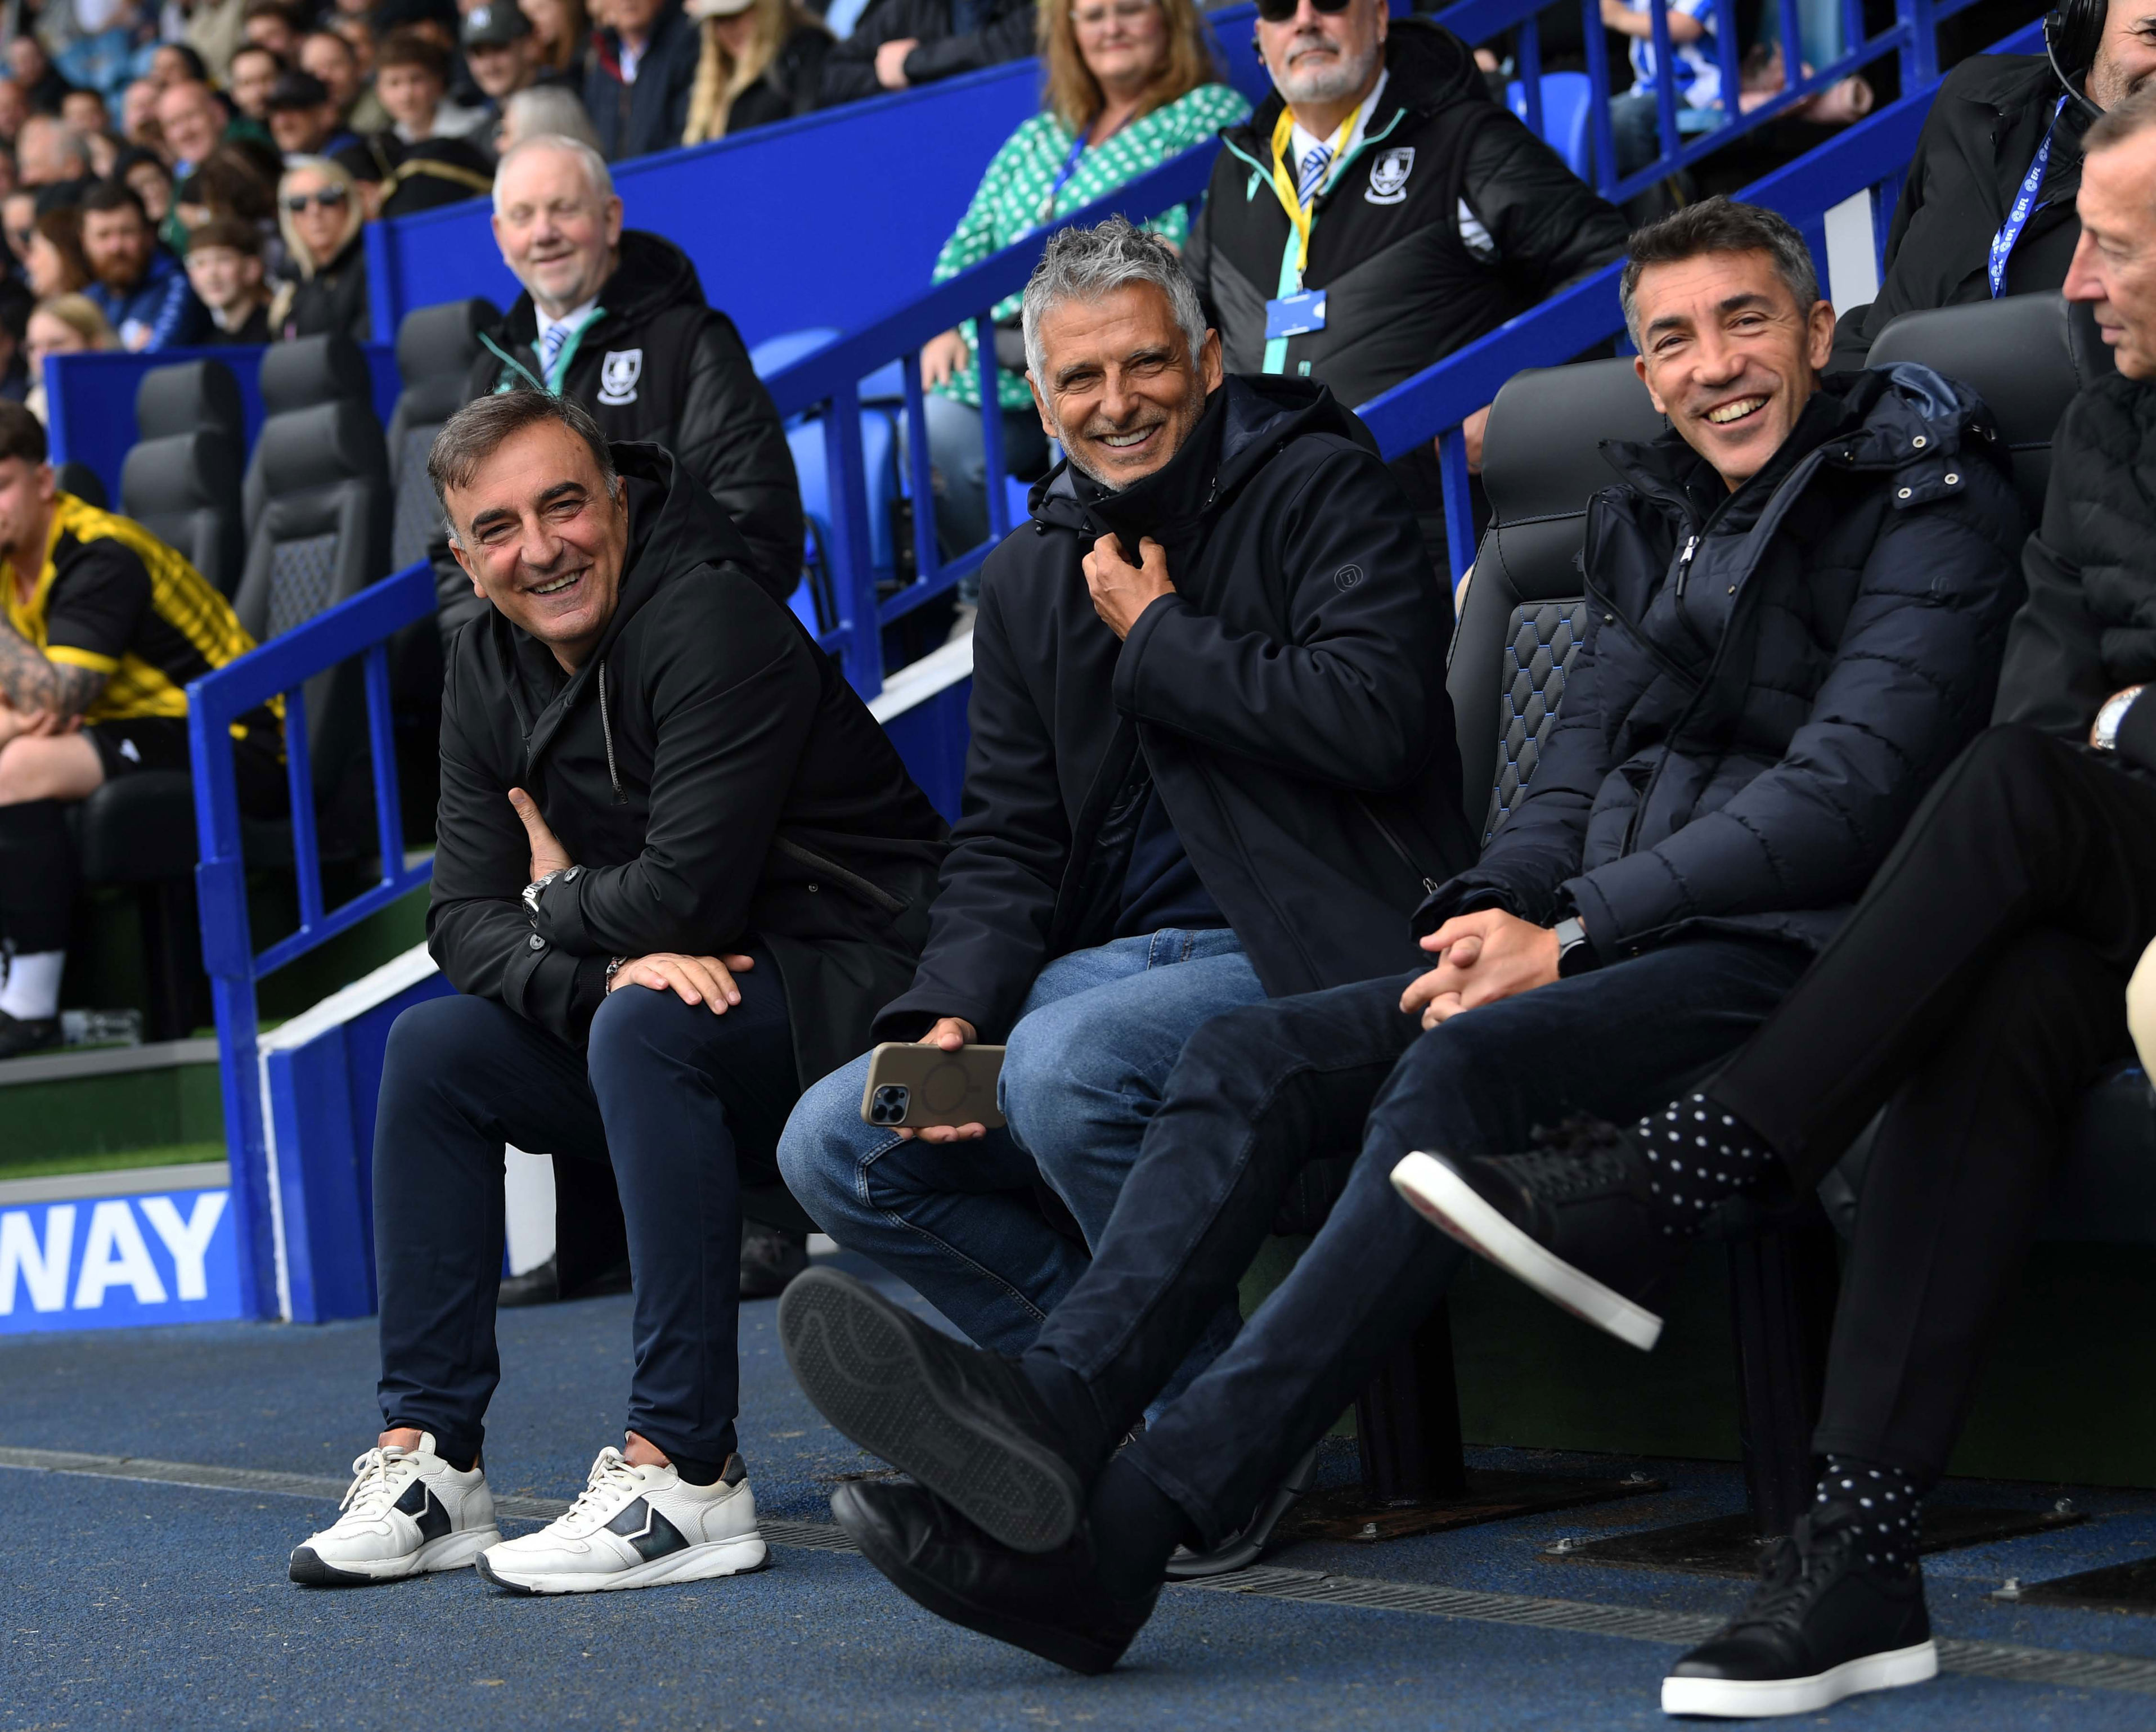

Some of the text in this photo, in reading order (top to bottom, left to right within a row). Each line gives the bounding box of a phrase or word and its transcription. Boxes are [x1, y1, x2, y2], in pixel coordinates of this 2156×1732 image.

[2031, 167, 2041, 181] EFL
[2017, 197, 2029, 211] EFL
[2005, 228, 2016, 241] EFL
